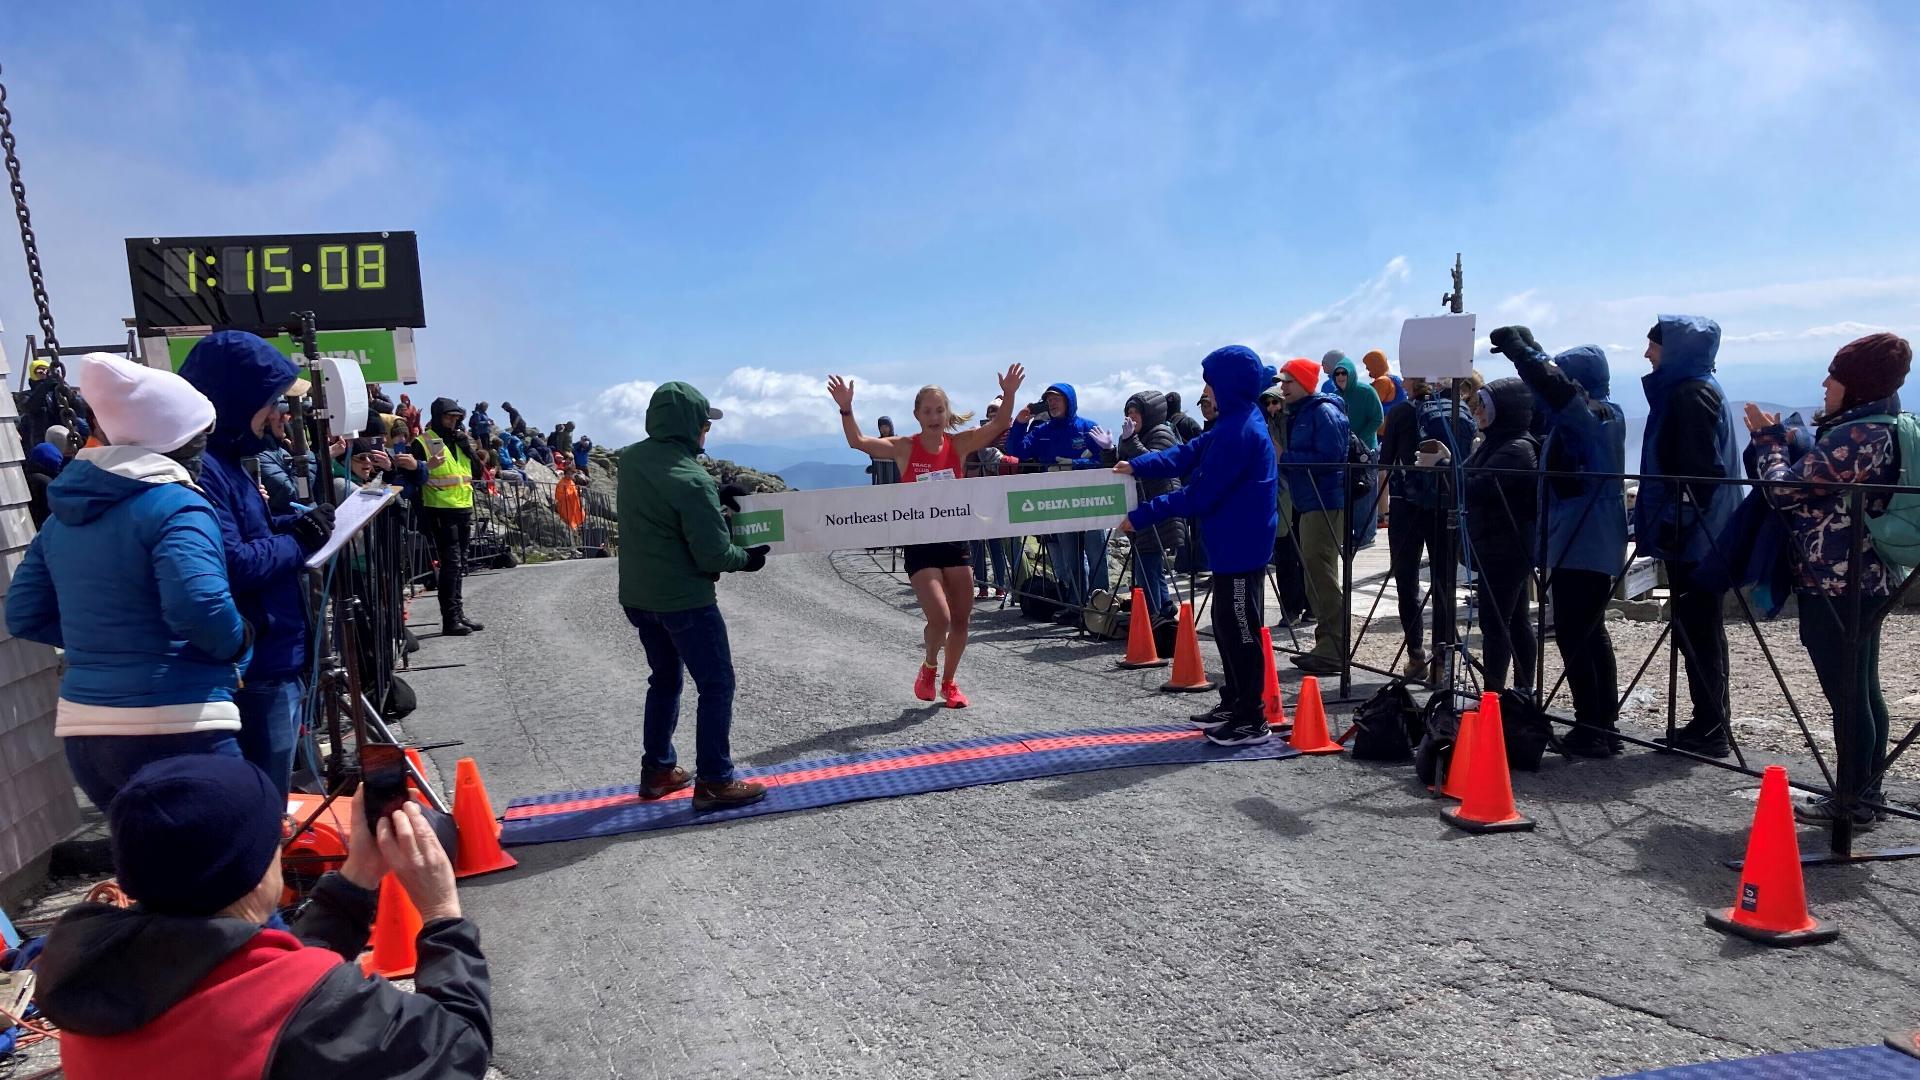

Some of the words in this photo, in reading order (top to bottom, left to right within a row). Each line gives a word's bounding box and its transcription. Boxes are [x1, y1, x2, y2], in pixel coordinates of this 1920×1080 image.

[290, 349, 372, 366] DTAL
[1037, 499, 1070, 511] DELTA
[1071, 495, 1115, 508] DENTAL
[825, 511, 888, 526] Northeast
[892, 507, 925, 522] Delta
[930, 503, 971, 519] Dental
[732, 521, 770, 536] ENTAL
